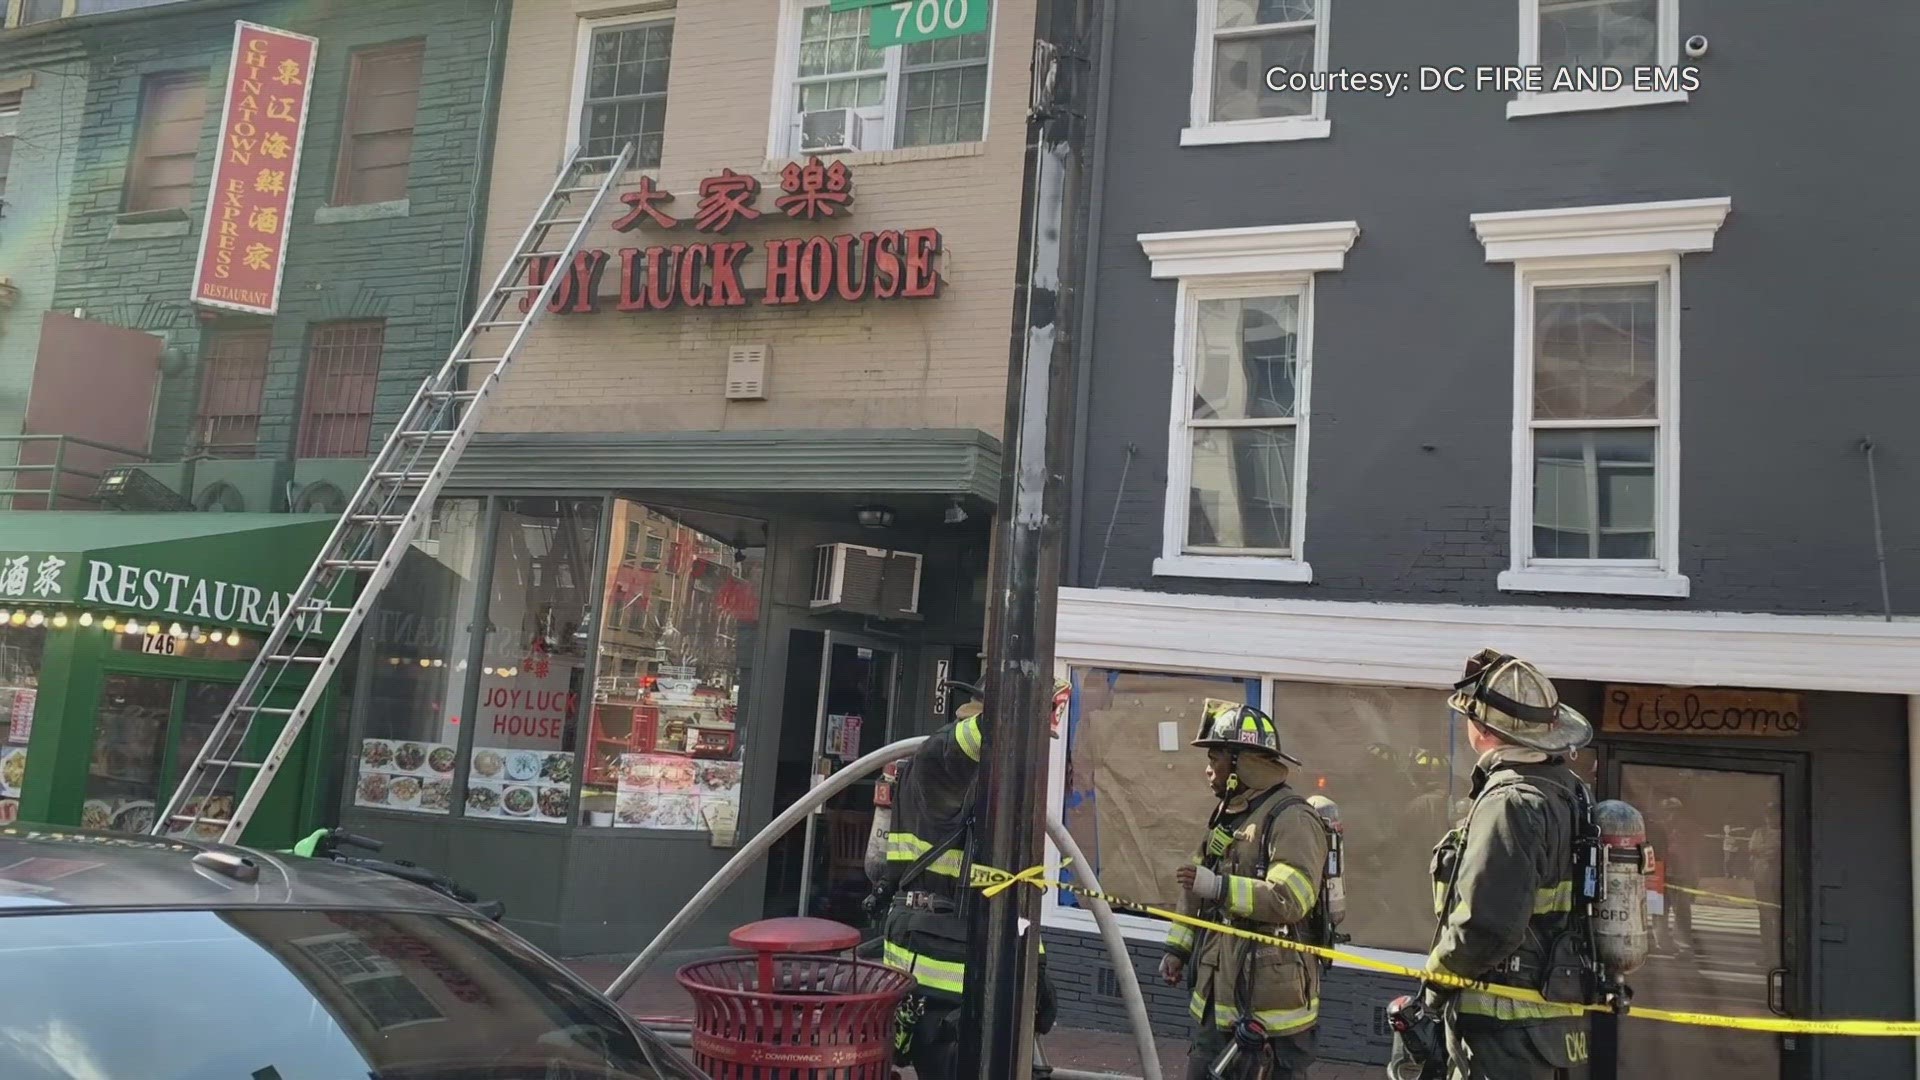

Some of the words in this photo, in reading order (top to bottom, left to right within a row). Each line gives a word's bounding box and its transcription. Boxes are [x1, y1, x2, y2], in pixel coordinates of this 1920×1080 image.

[891, 0, 967, 38] 700
[229, 39, 269, 166] CHINATOWN
[242, 58, 303, 271] 東江海鮮酒家
[612, 155, 855, 234] 大家樂
[214, 178, 245, 279] EXPRESS
[203, 282, 269, 305] RESTAURANT
[616, 240, 751, 312] LUCK
[761, 228, 942, 306] HOUSE
[145, 633, 175, 654] 746
[484, 688, 521, 710] JOY
[525, 689, 579, 714] LUCK
[935, 660, 948, 713] 748
[493, 714, 562, 739] HOUSE
[1612, 690, 1800, 732] Welcome
